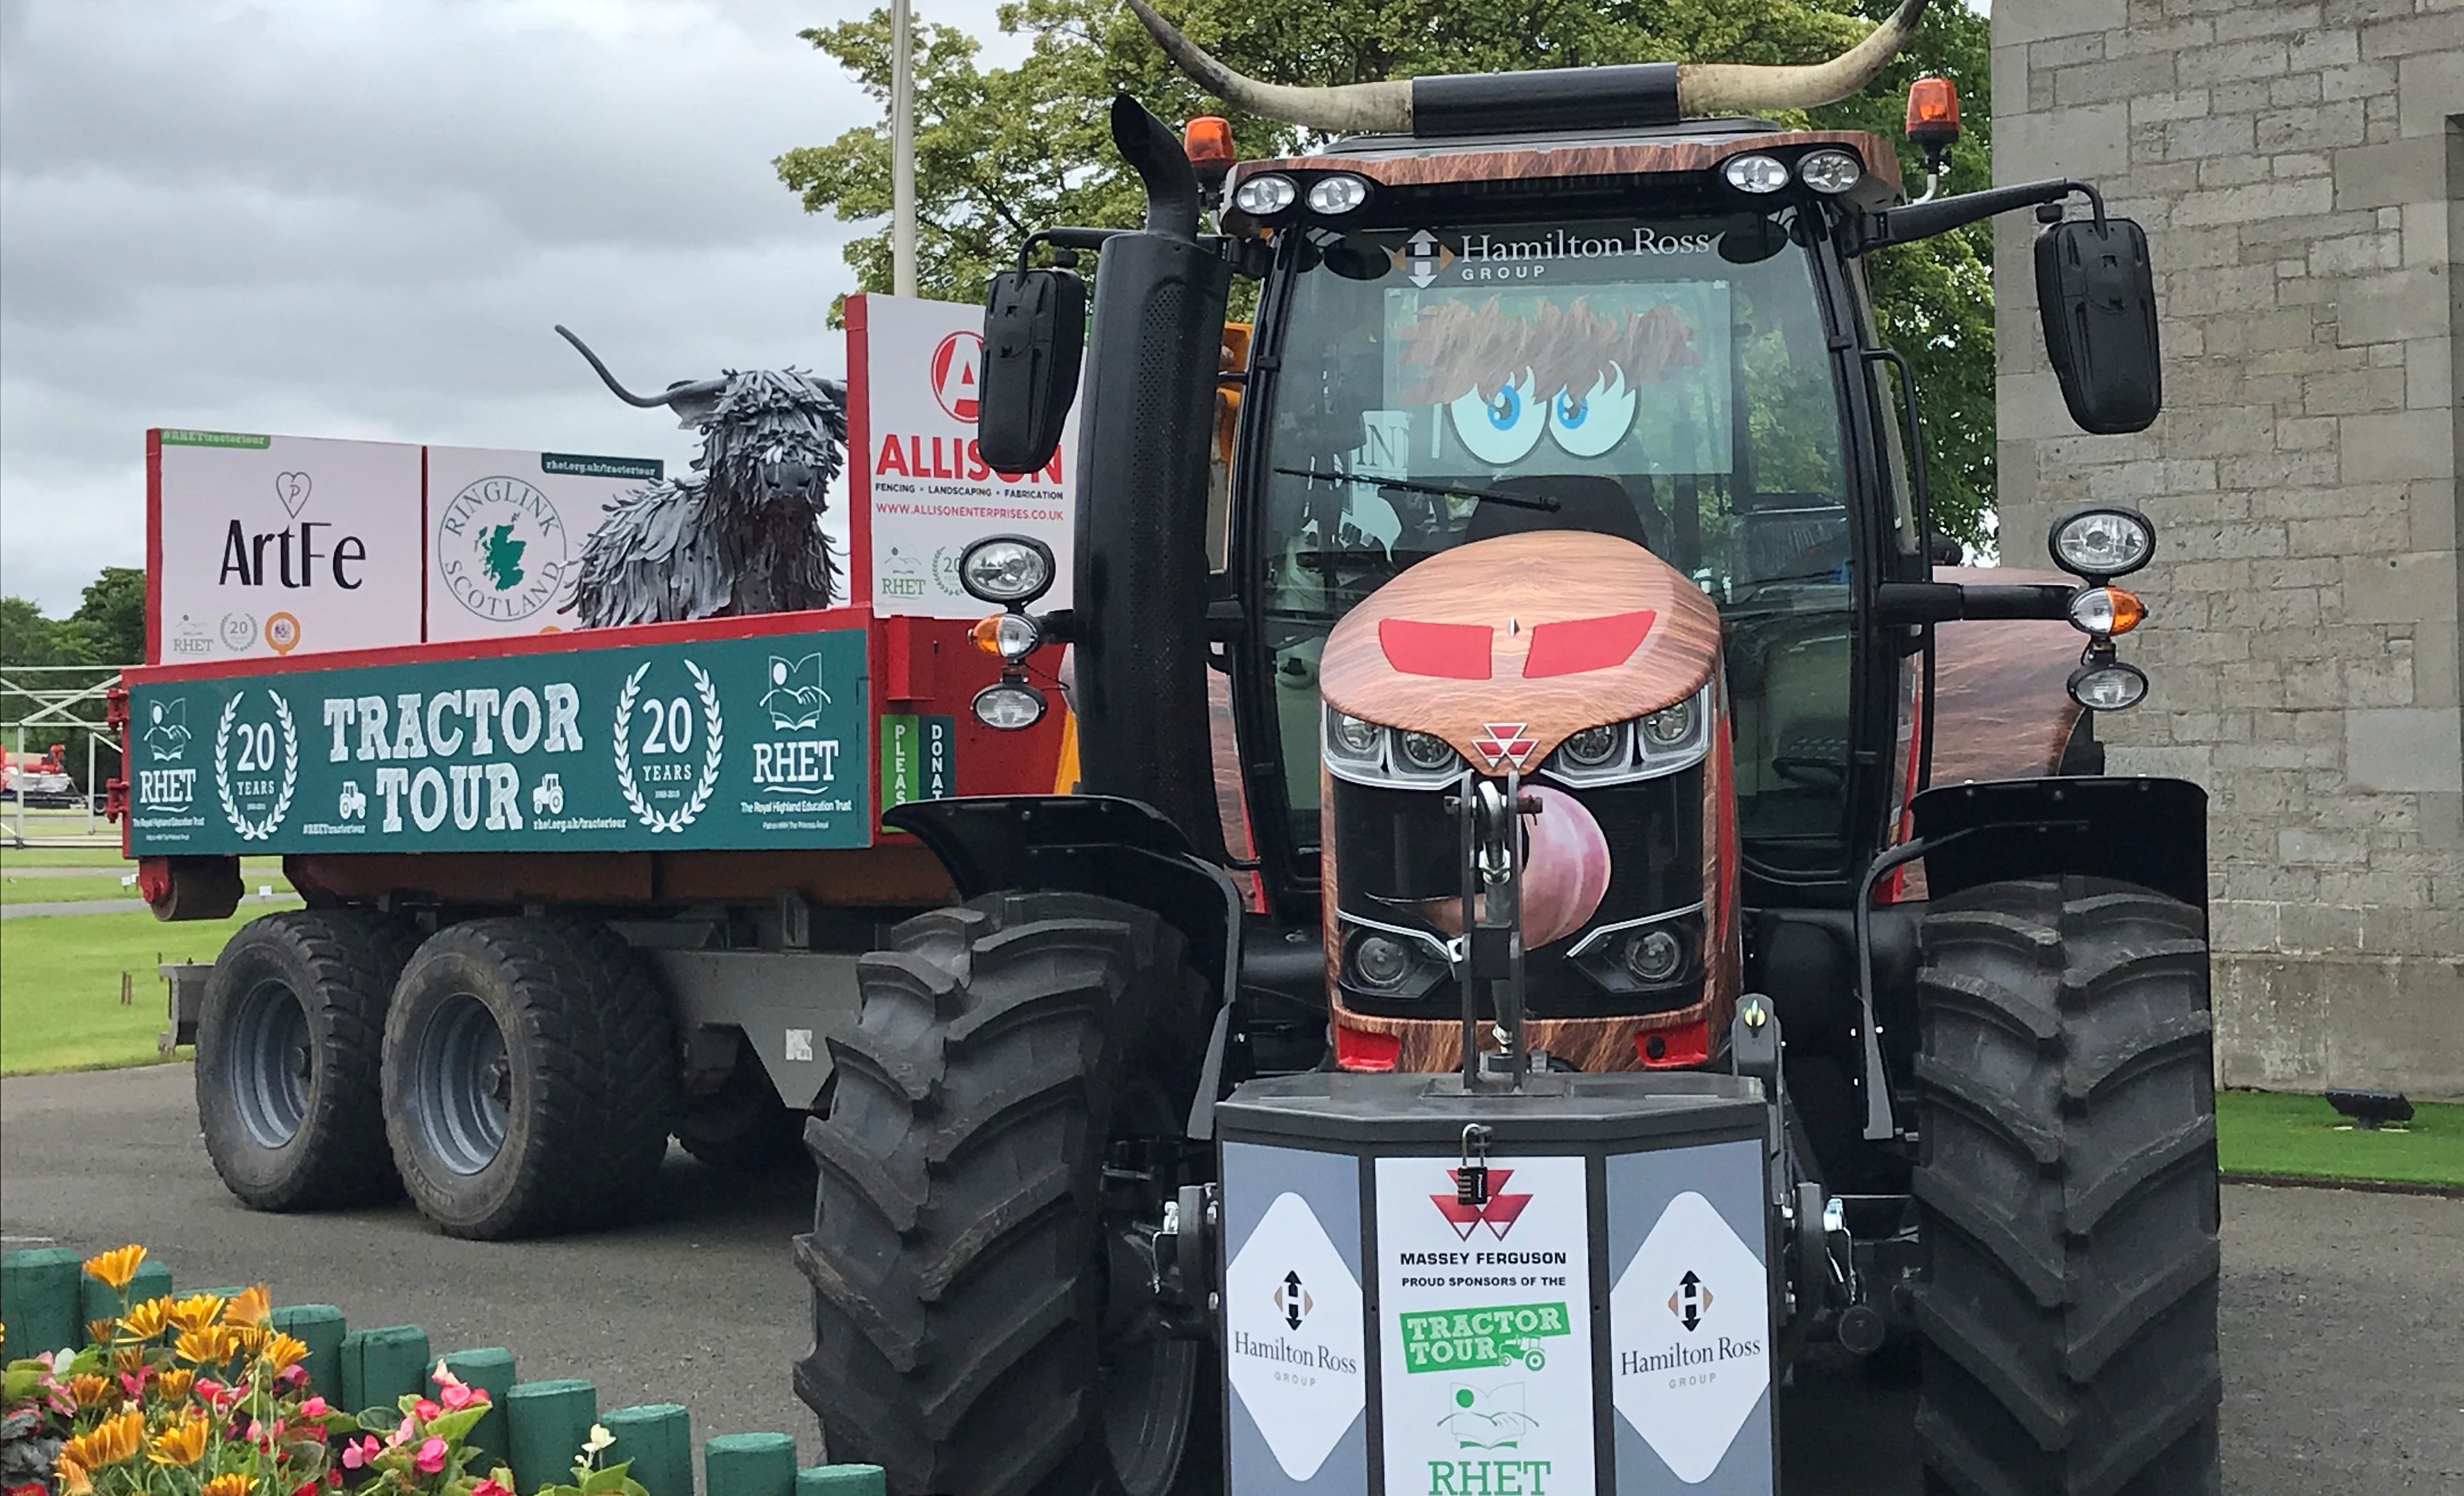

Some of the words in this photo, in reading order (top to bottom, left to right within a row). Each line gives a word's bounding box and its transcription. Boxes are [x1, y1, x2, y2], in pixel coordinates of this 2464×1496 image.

[1461, 229, 1624, 264] Hamilton
[1632, 227, 1711, 256] Ross
[1461, 266, 1546, 281] GROUP
[876, 434, 1062, 484] ALLISN
[876, 482, 915, 493] FENCING
[928, 485, 991, 497] LANDSCAPING
[1004, 489, 1064, 500] FABRICATION
[445, 481, 559, 537] RINGLINK
[876, 502, 1064, 521] WWW.ALLISONENTERPRISES.CO.UK
[219, 520, 365, 589] ArtFe
[445, 559, 561, 617] SCOTLAND
[882, 578, 926, 595] RHET
[173, 639, 214, 652] RHET
[230, 621, 248, 635] 20
[324, 682, 582, 762] TRACTOR
[642, 697, 692, 754] 20
[237, 722, 275, 771] 20
[753, 740, 838, 783] RHET
[932, 724, 943, 799] DONAT
[643, 763, 692, 781] YEARS
[895, 724, 906, 805] PLEAS
[140, 768, 196, 803] RHET
[237, 780, 275, 796] YEARS
[376, 762, 523, 832] TOUR
[1400, 1253, 1470, 1265] MASSEY
[1476, 1252, 1566, 1265] FERGUSON
[1402, 1277, 1445, 1287] PROUD
[1449, 1277, 1517, 1287] SPONSORS
[1521, 1277, 1537, 1286] OF
[1541, 1277, 1566, 1286] THE
[1407, 1307, 1562, 1341] TRACTOR
[1235, 1331, 1314, 1367] Hamilton
[1318, 1345, 1357, 1374] Ross
[1409, 1337, 1498, 1365] TOUR
[1621, 1342, 1713, 1376] Hamilton
[1718, 1336, 1761, 1360] Ross
[1274, 1371, 1316, 1387] GROUP
[1668, 1373, 1716, 1389] GROUP
[1428, 1461, 1551, 1496] RHET
